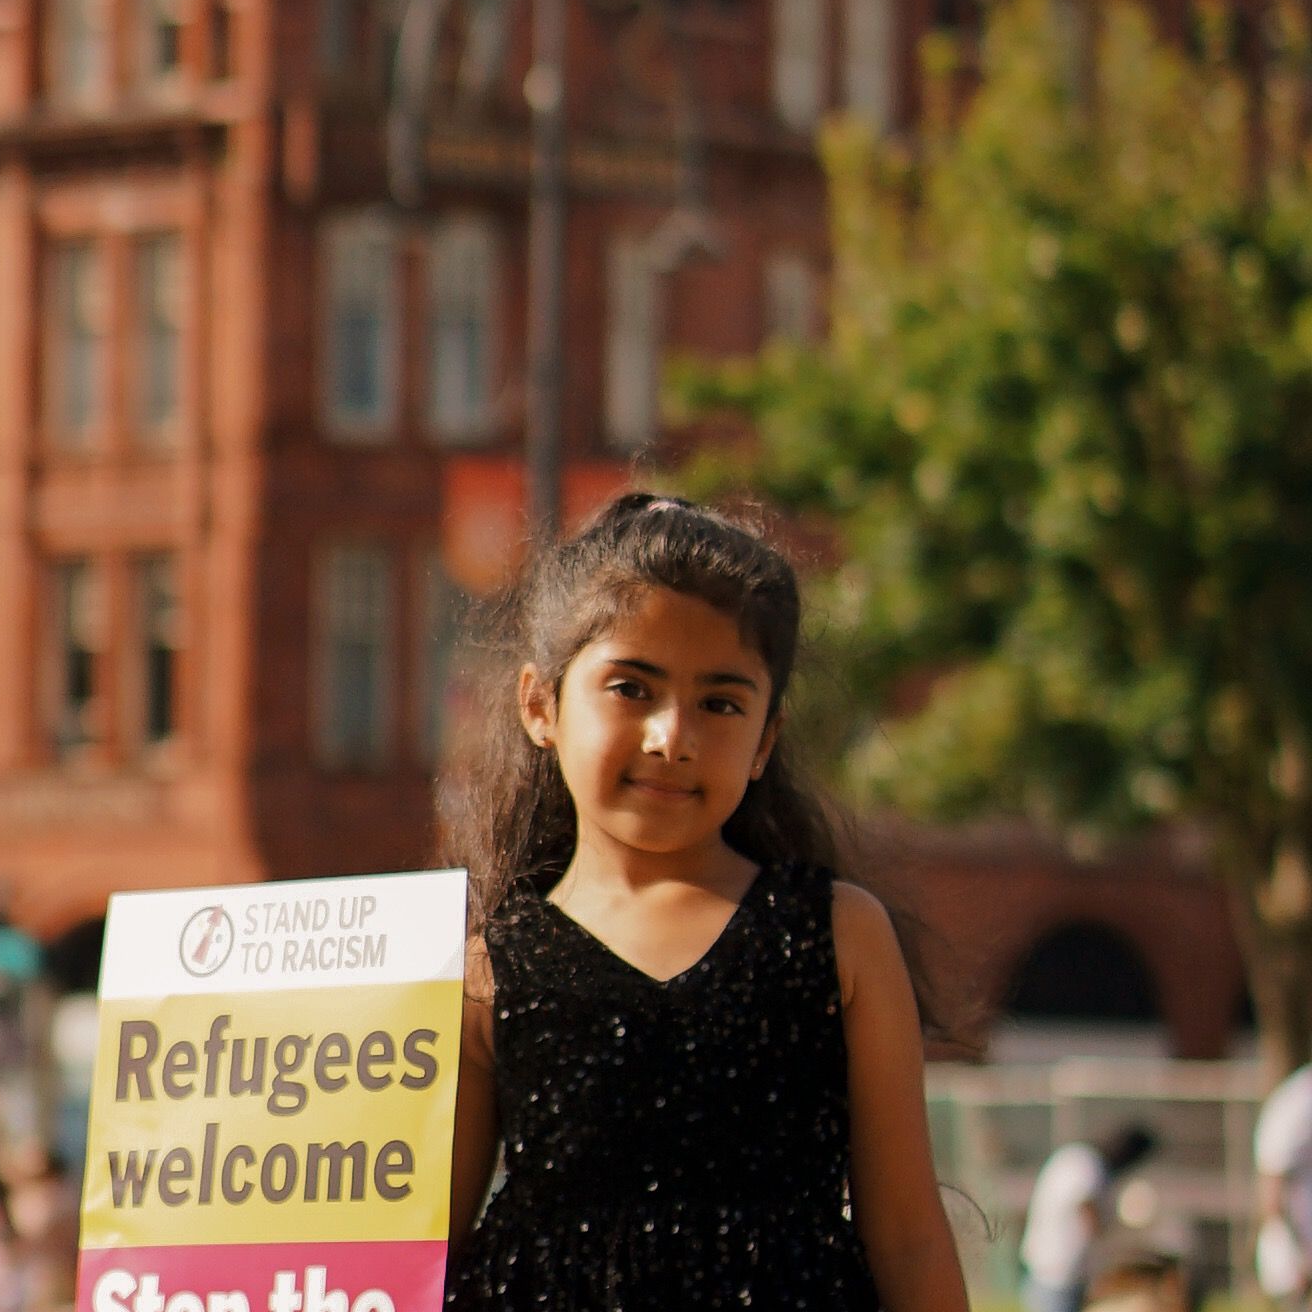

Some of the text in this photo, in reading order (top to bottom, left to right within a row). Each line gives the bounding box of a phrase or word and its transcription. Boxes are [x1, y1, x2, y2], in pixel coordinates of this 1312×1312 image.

[244, 895, 378, 936] STAND UP
[240, 933, 388, 975] TO RACISM
[115, 1014, 441, 1117] Refugees
[108, 1122, 416, 1209] welcome
